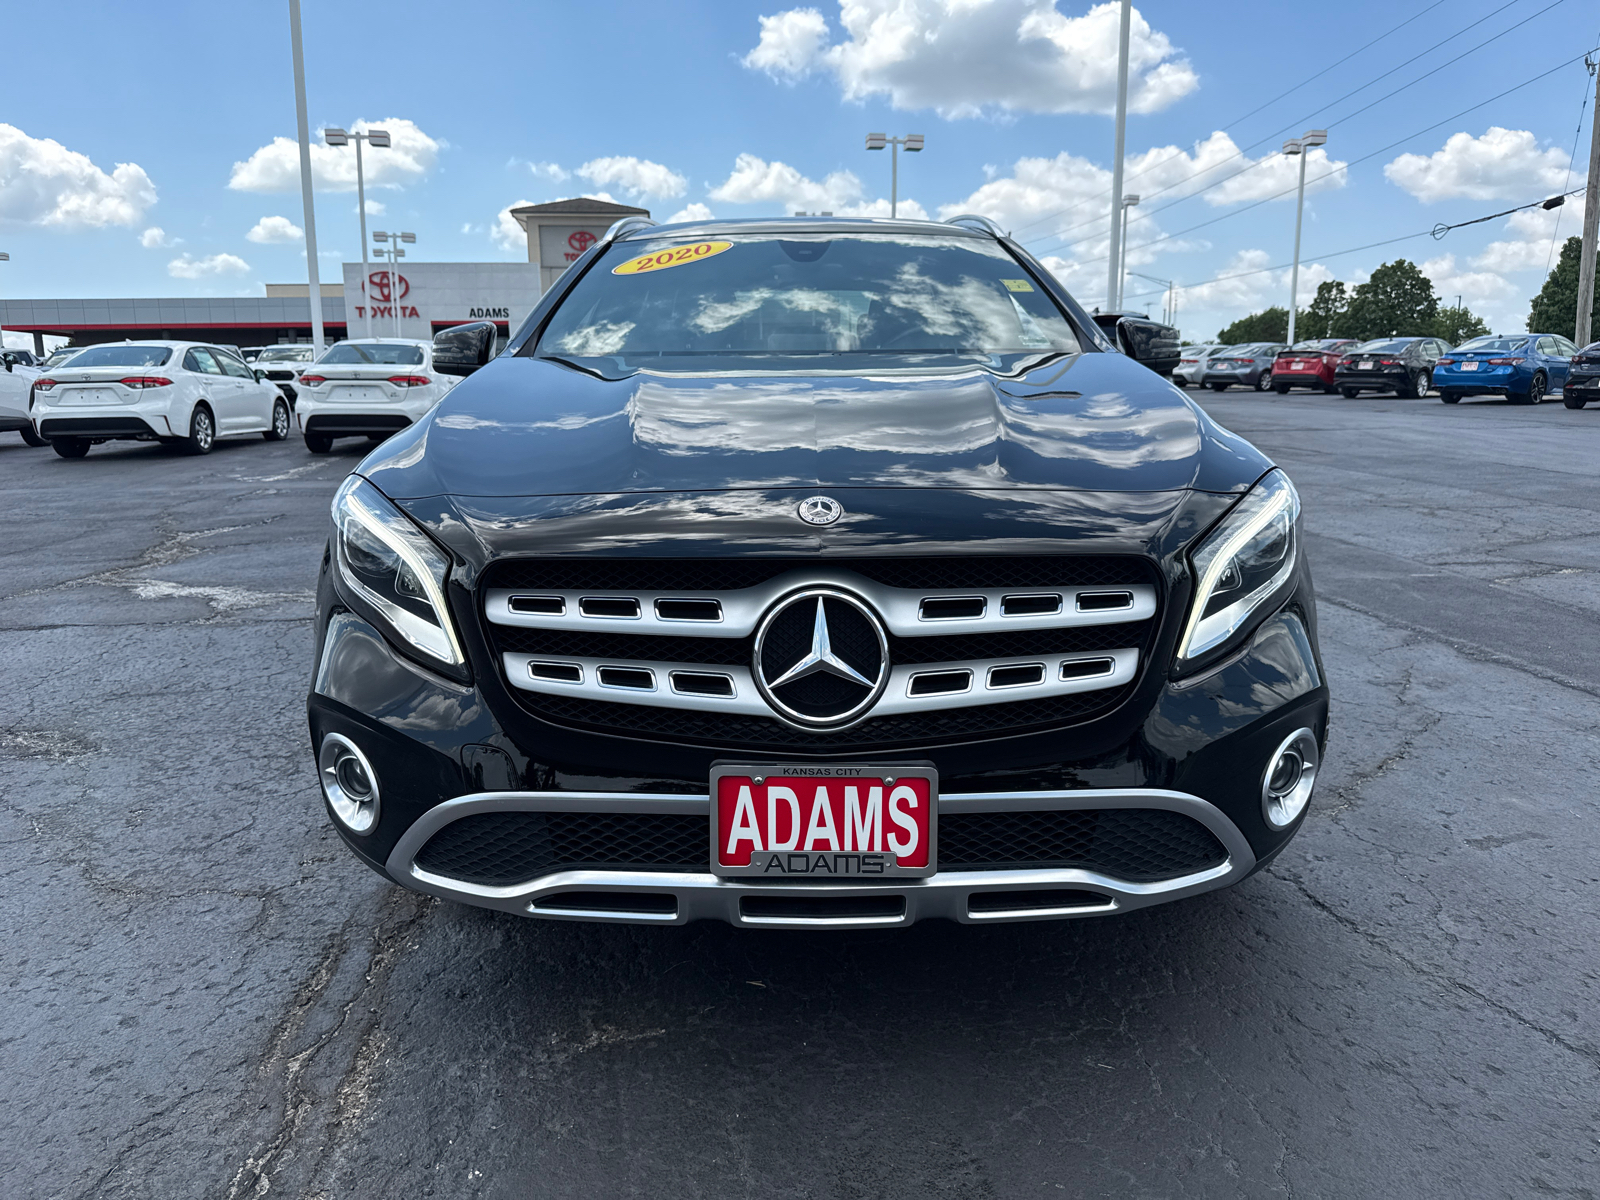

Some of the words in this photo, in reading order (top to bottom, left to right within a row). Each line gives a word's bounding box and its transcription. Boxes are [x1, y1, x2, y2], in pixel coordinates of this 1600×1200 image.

[637, 244, 712, 271] 2020
[469, 307, 509, 318] ADAMS
[783, 768, 831, 776] KANSAS
[836, 768, 862, 776] CITY
[726, 785, 919, 857] ADAMS
[764, 854, 884, 873] ADAMS
